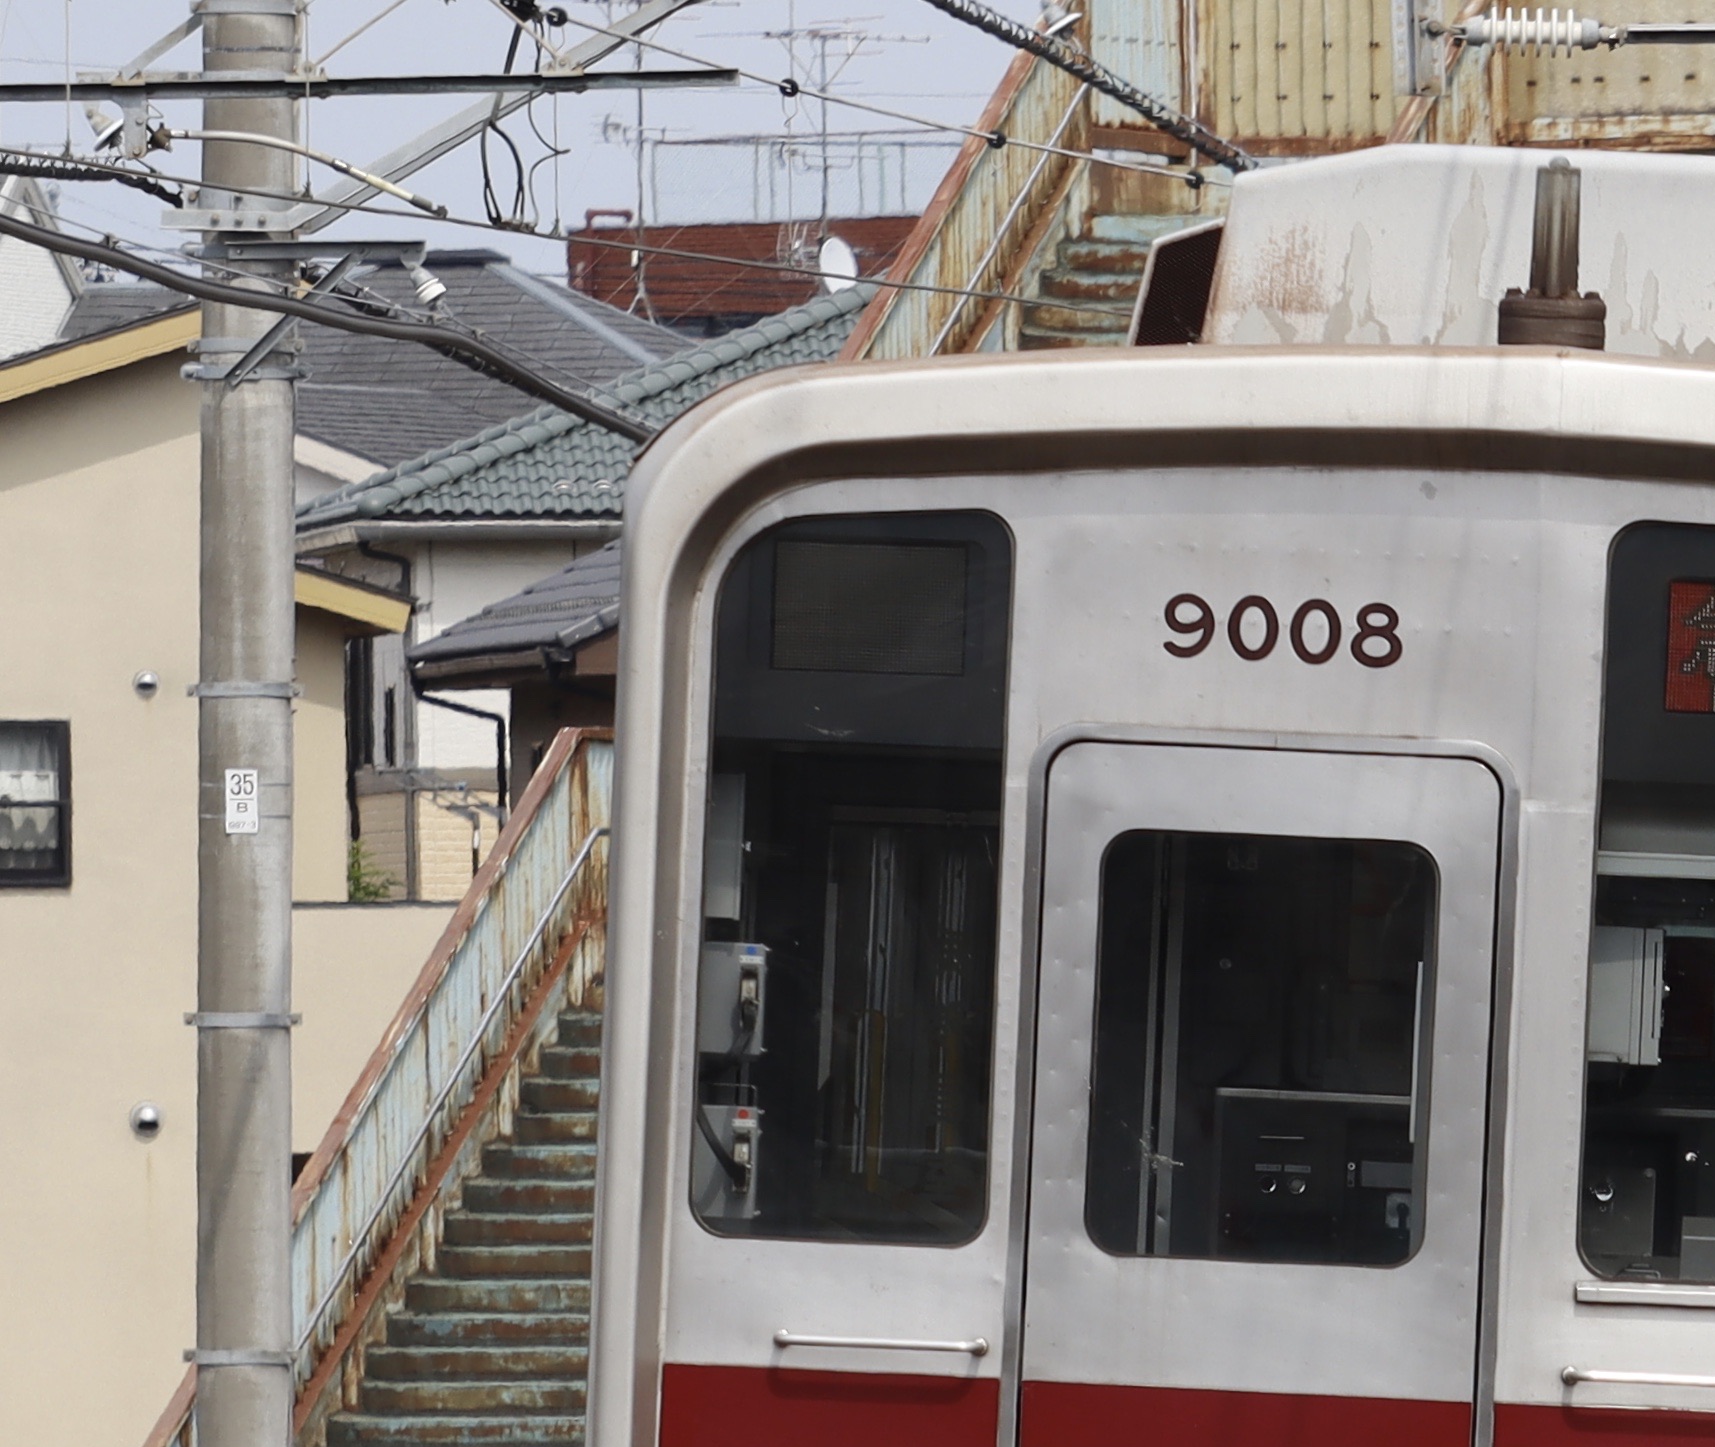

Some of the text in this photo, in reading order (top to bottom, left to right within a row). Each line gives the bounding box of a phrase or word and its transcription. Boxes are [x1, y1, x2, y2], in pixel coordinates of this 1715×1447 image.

[1163, 593, 1403, 668] 9008
[230, 773, 254, 796] 35
[236, 802, 248, 813] B
